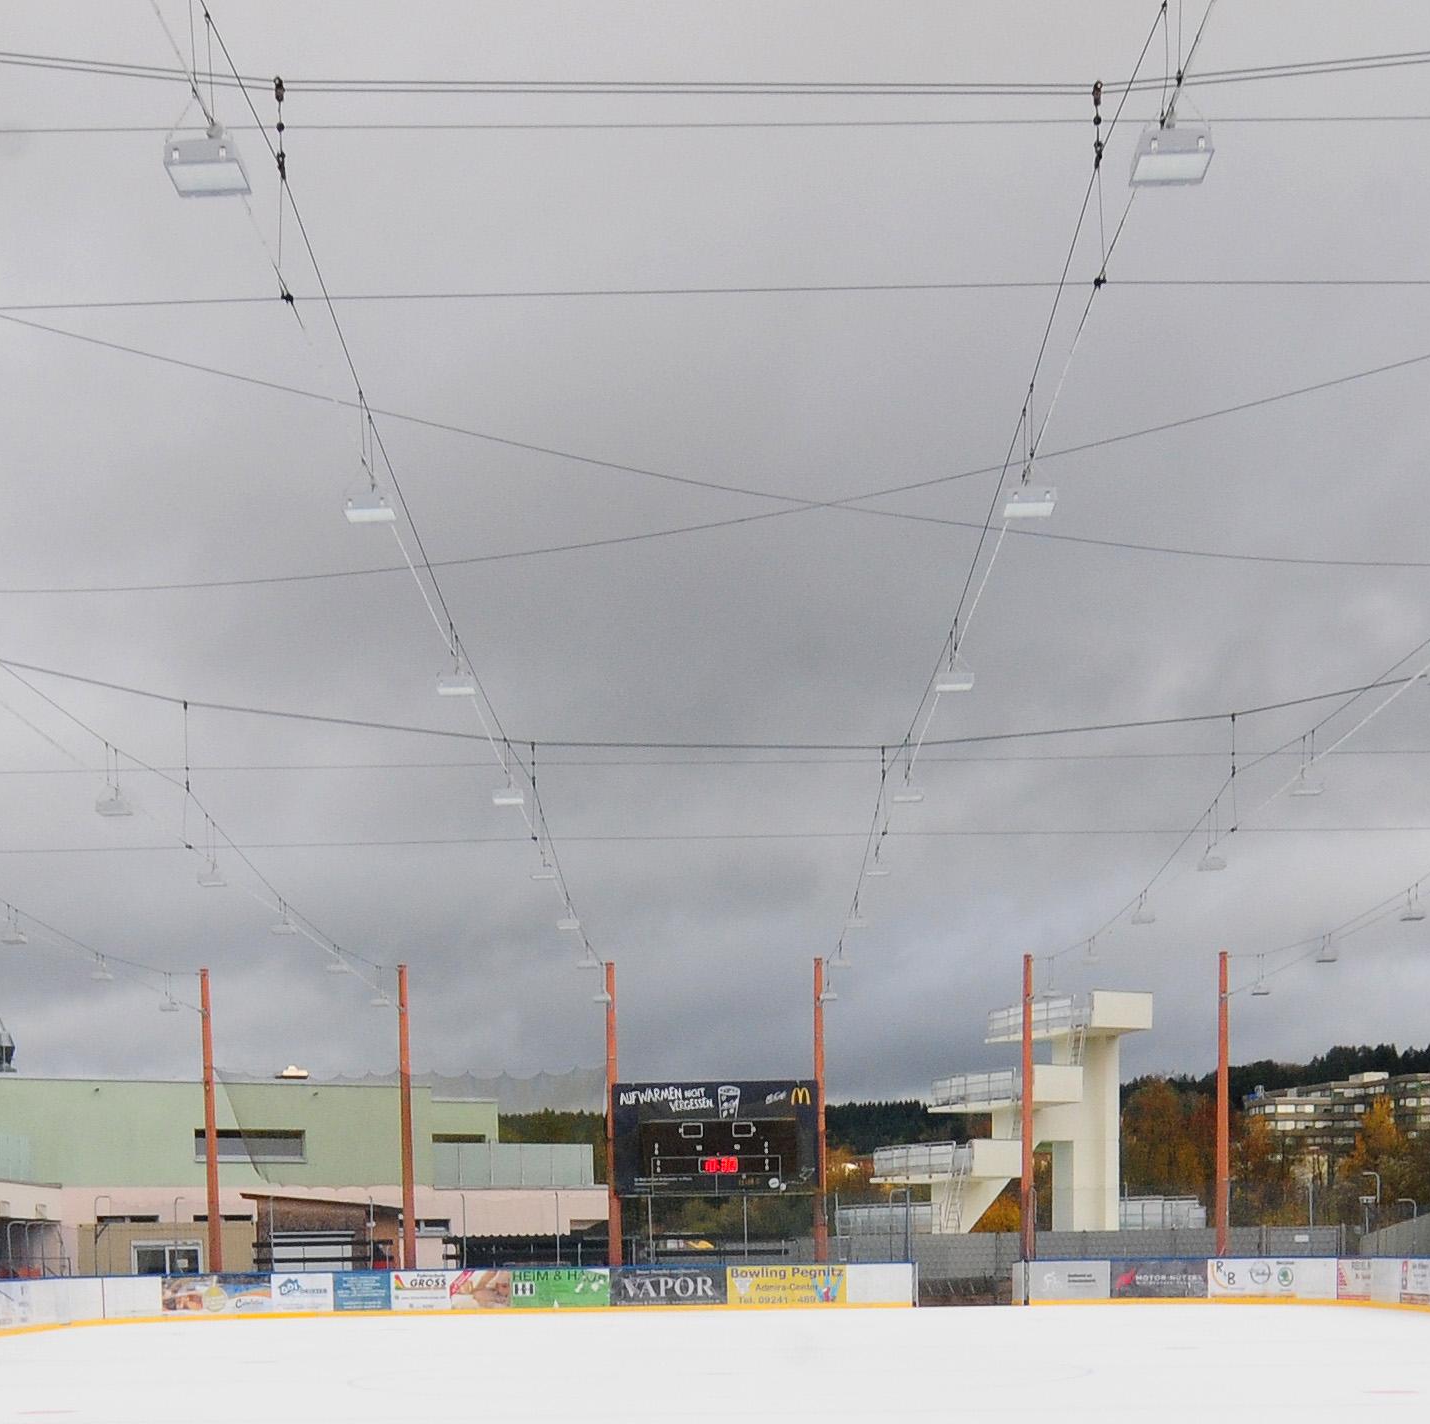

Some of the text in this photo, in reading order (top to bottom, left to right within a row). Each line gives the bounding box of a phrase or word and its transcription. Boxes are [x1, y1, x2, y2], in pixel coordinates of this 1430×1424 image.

[668, 1098, 714, 1113] VERGESSEN
[1216, 1261, 1223, 1272] R
[513, 1270, 550, 1282] HEIM
[553, 1270, 563, 1281] &
[731, 1267, 844, 1280] Bowling Pegnitz
[410, 1278, 447, 1288] GROSS
[621, 1276, 714, 1298] VAPOR
